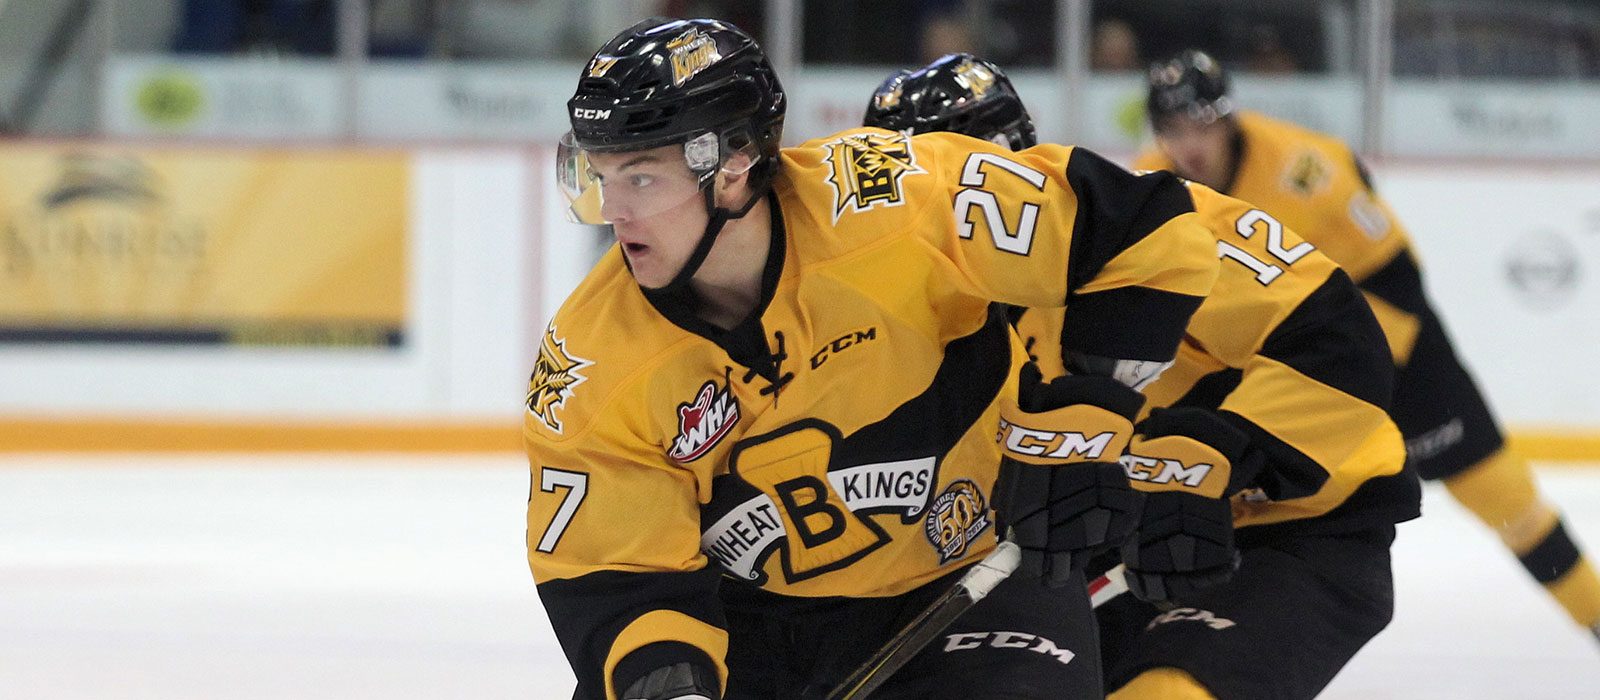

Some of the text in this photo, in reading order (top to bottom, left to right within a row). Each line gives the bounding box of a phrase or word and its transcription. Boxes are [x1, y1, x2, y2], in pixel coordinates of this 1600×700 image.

[574, 107, 612, 120] CCM
[953, 152, 1048, 257] 27
[1217, 208, 1317, 287] 12
[809, 327, 876, 371] CCM
[709, 468, 930, 567] WHEAT KINGS
[774, 475, 847, 550] B
[943, 631, 1076, 665] CCM
